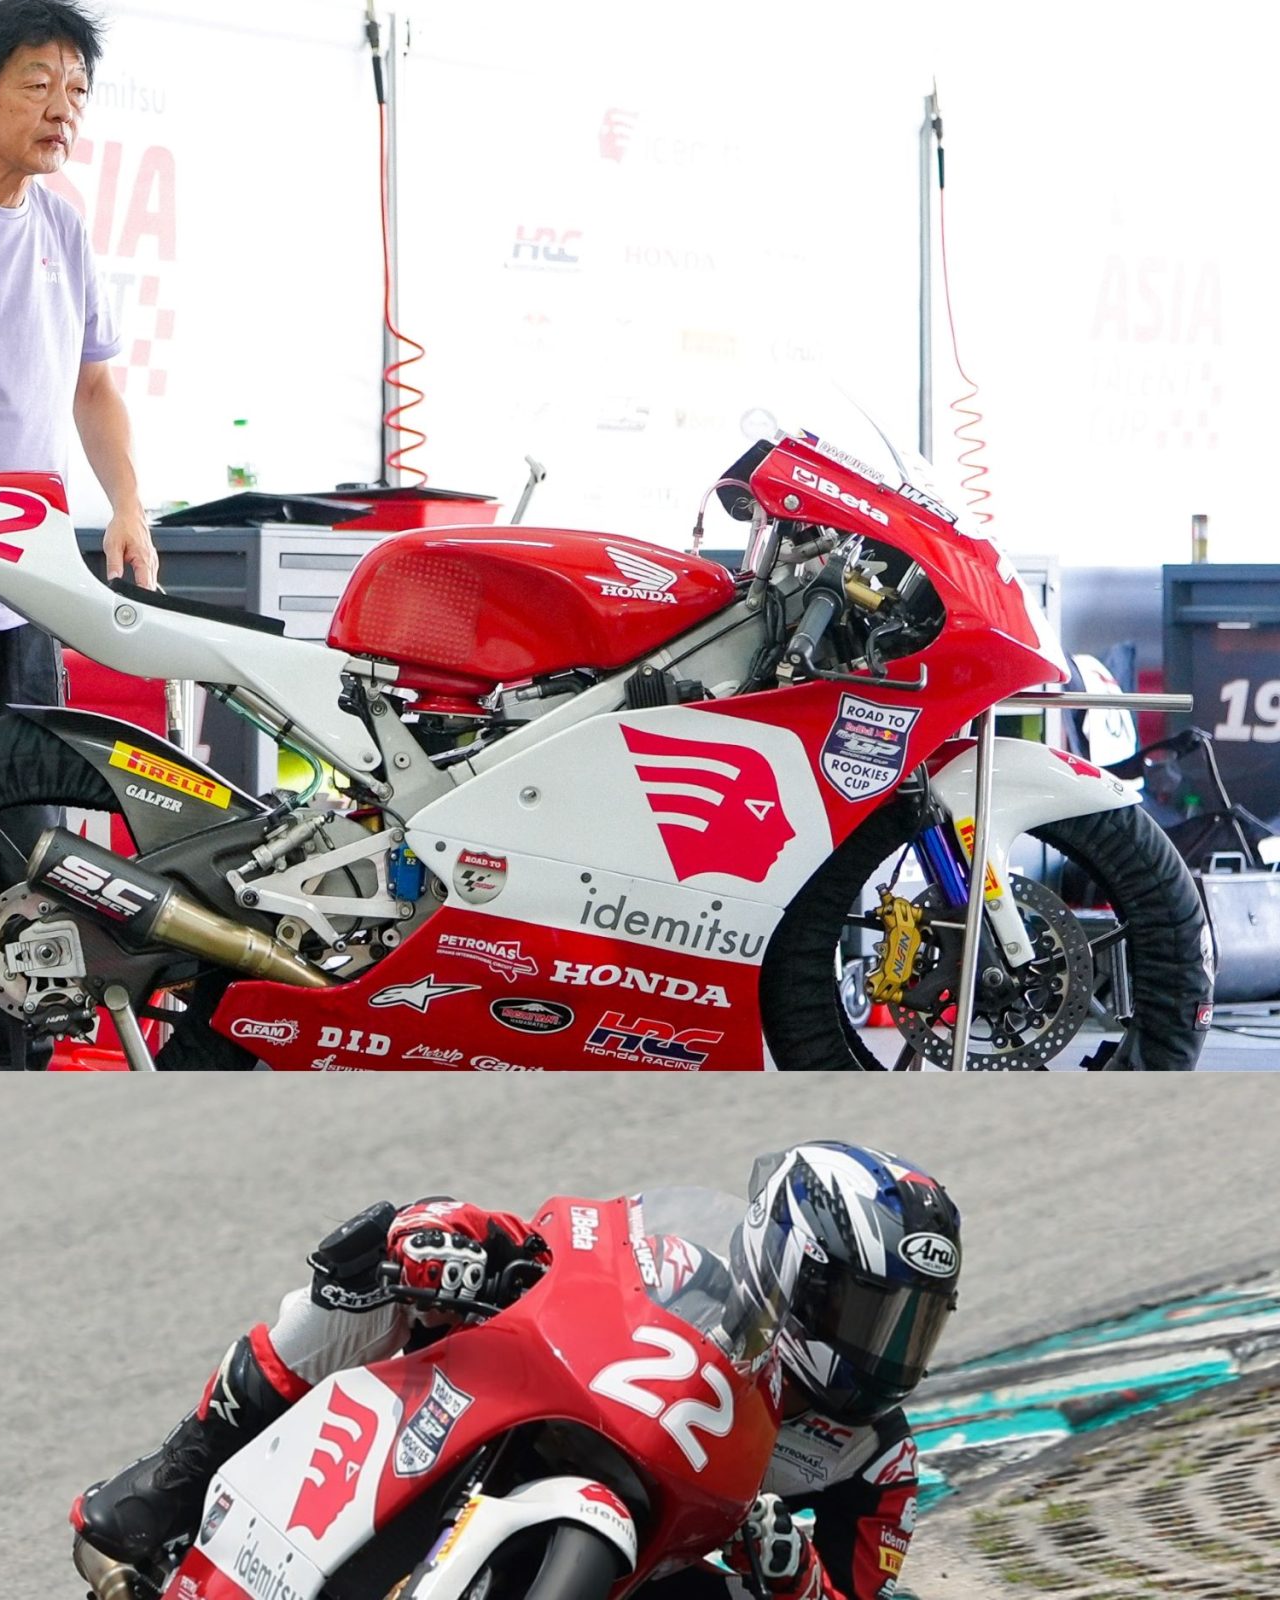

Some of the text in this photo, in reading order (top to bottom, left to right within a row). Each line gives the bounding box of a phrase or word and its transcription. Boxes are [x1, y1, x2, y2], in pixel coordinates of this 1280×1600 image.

[817, 477, 889, 527] Beta
[600, 584, 678, 604] HONDA
[847, 705, 905, 727] ROAD TO
[127, 750, 217, 799] PIRELLI
[832, 759, 889, 782] ROOKIES
[844, 777, 870, 790] CUP
[125, 784, 184, 813] GALFER
[465, 856, 501, 868] ROAD TO
[46, 871, 135, 916] PROJECT
[53, 855, 157, 912] SC
[580, 887, 765, 959] idemitsu
[439, 934, 517, 960] PETRONAS
[550, 959, 732, 1008] HONDA
[241, 1023, 286, 1038] AFAM
[317, 1026, 391, 1056] D.I.D
[585, 1011, 725, 1064] HRC
[583, 1044, 701, 1071] Honda RACING
[572, 1218, 599, 1251] Beta
[907, 1239, 954, 1267] Arai
[435, 1383, 453, 1405] ROAD
[589, 1326, 734, 1472] 22
[400, 1451, 415, 1466] CUP
[401, 1433, 429, 1464] ROOKIES
